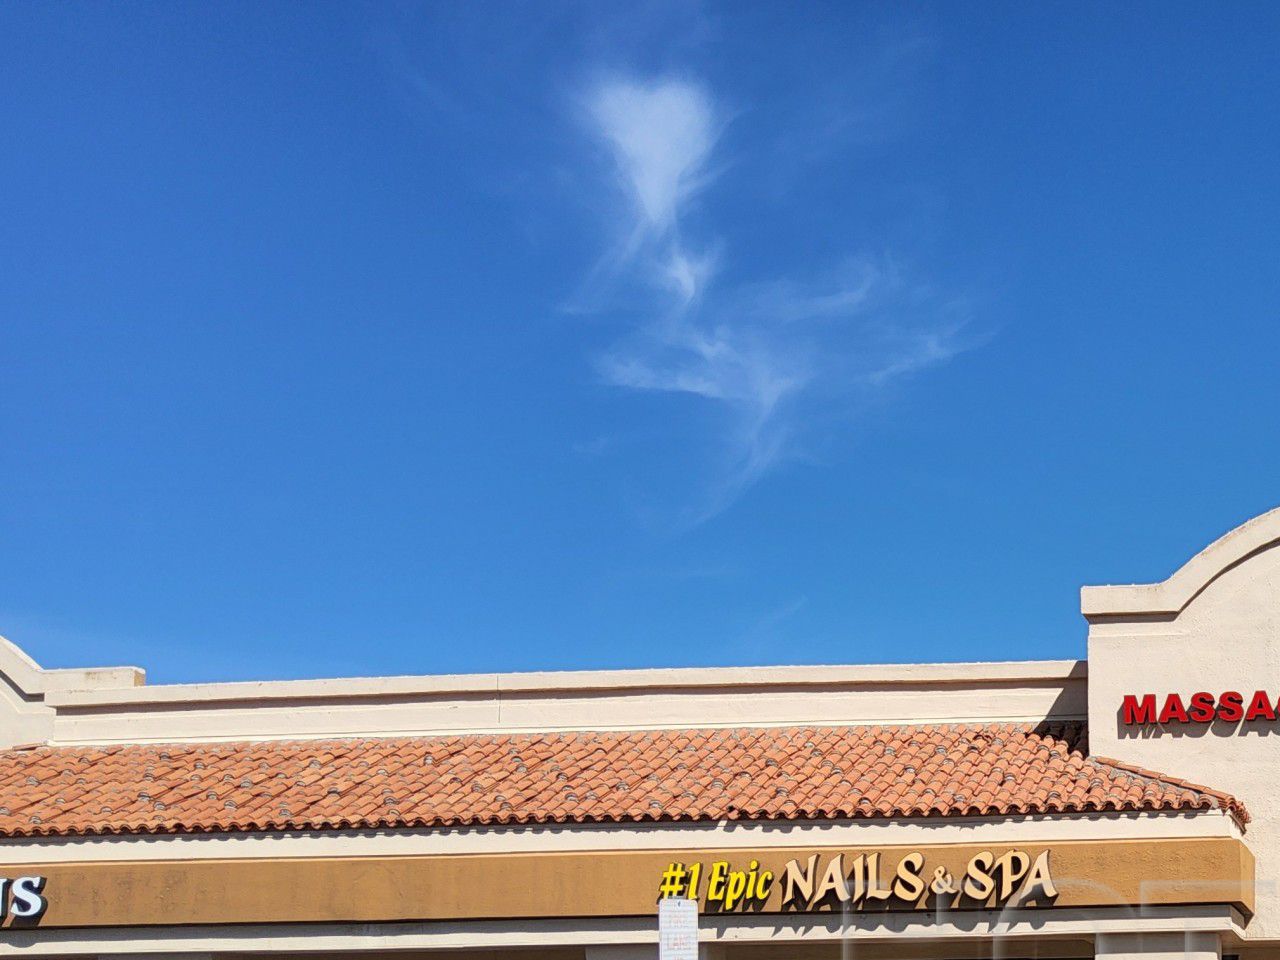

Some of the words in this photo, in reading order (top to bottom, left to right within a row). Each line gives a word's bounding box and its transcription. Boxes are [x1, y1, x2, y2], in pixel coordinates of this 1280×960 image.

[660, 862, 702, 899] #1
[707, 860, 773, 911] Epic
[783, 852, 924, 902] NAILS
[930, 865, 957, 895] &
[963, 849, 1058, 901] SPA
